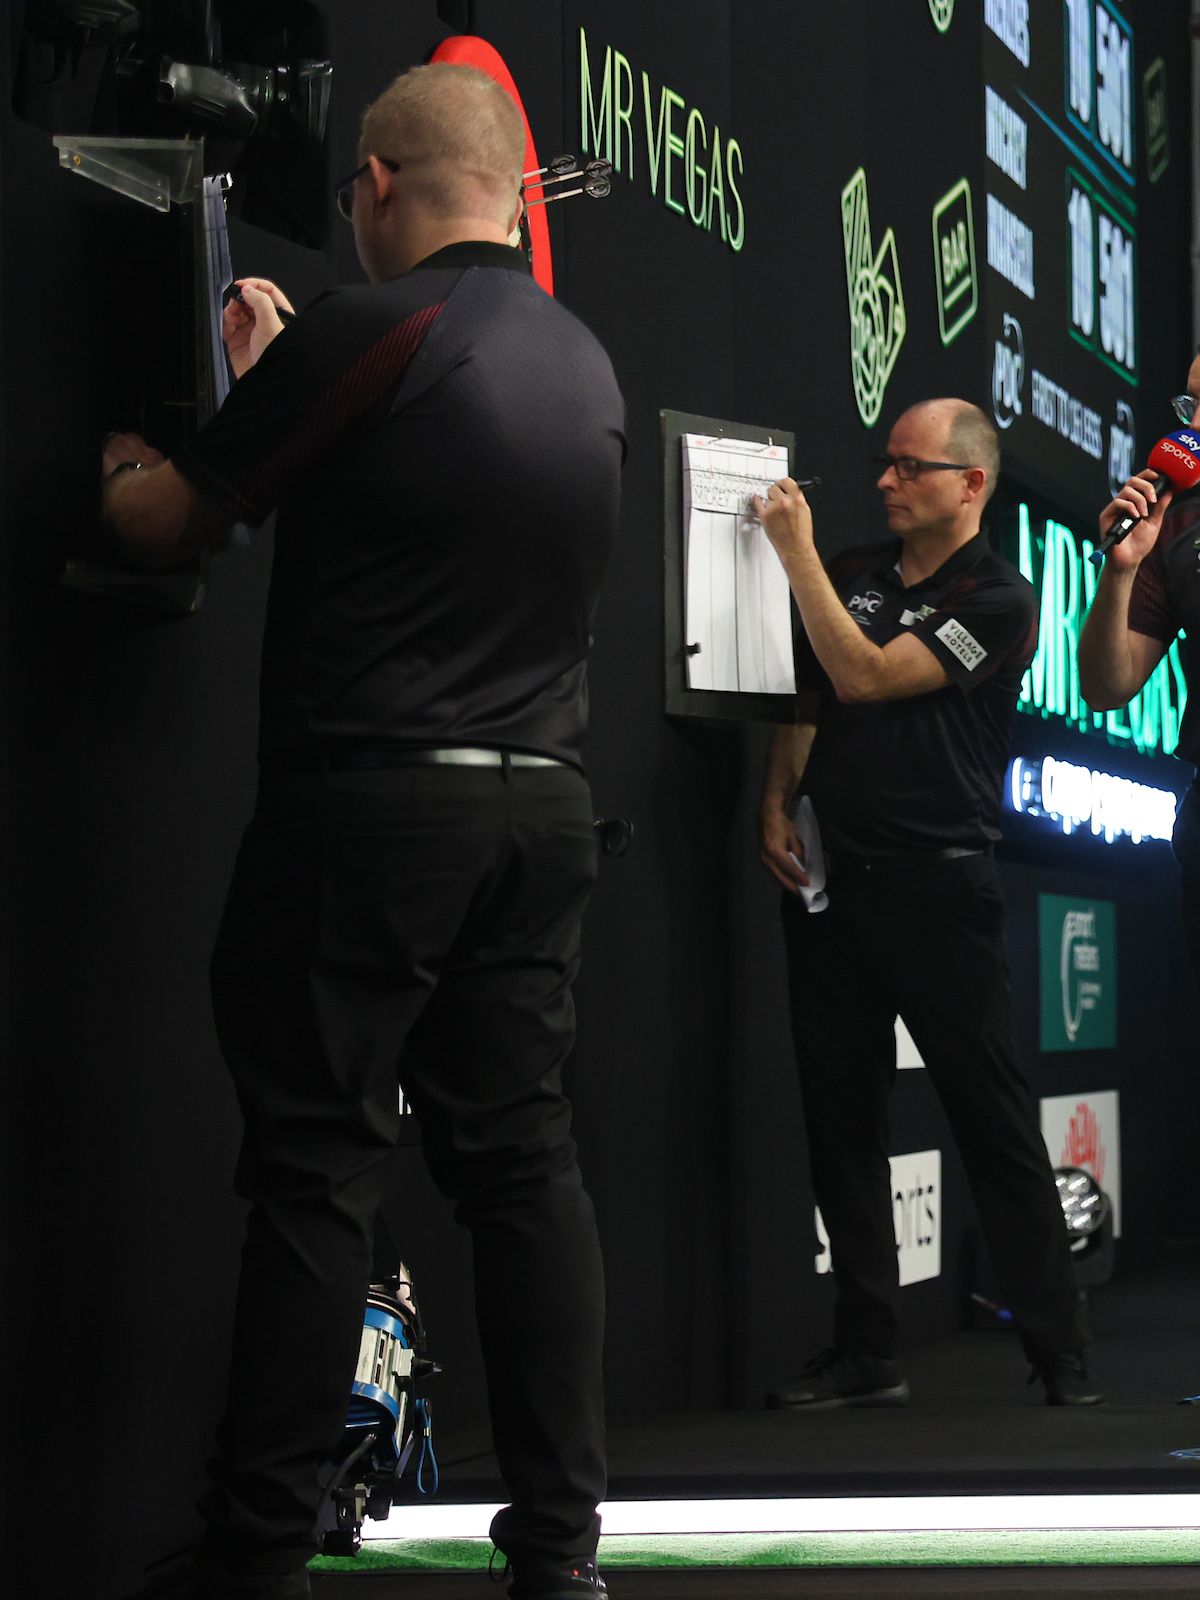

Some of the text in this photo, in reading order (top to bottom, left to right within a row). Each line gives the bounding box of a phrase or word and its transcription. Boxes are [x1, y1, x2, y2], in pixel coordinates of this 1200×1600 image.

[580, 26, 745, 251] MR VEGAS
[994, 340, 1023, 417] PDC
[1160, 441, 1198, 471] sports
[848, 596, 880, 613] PDC
[943, 632, 973, 663] HOTELS
[949, 622, 984, 660] VILLAGE
